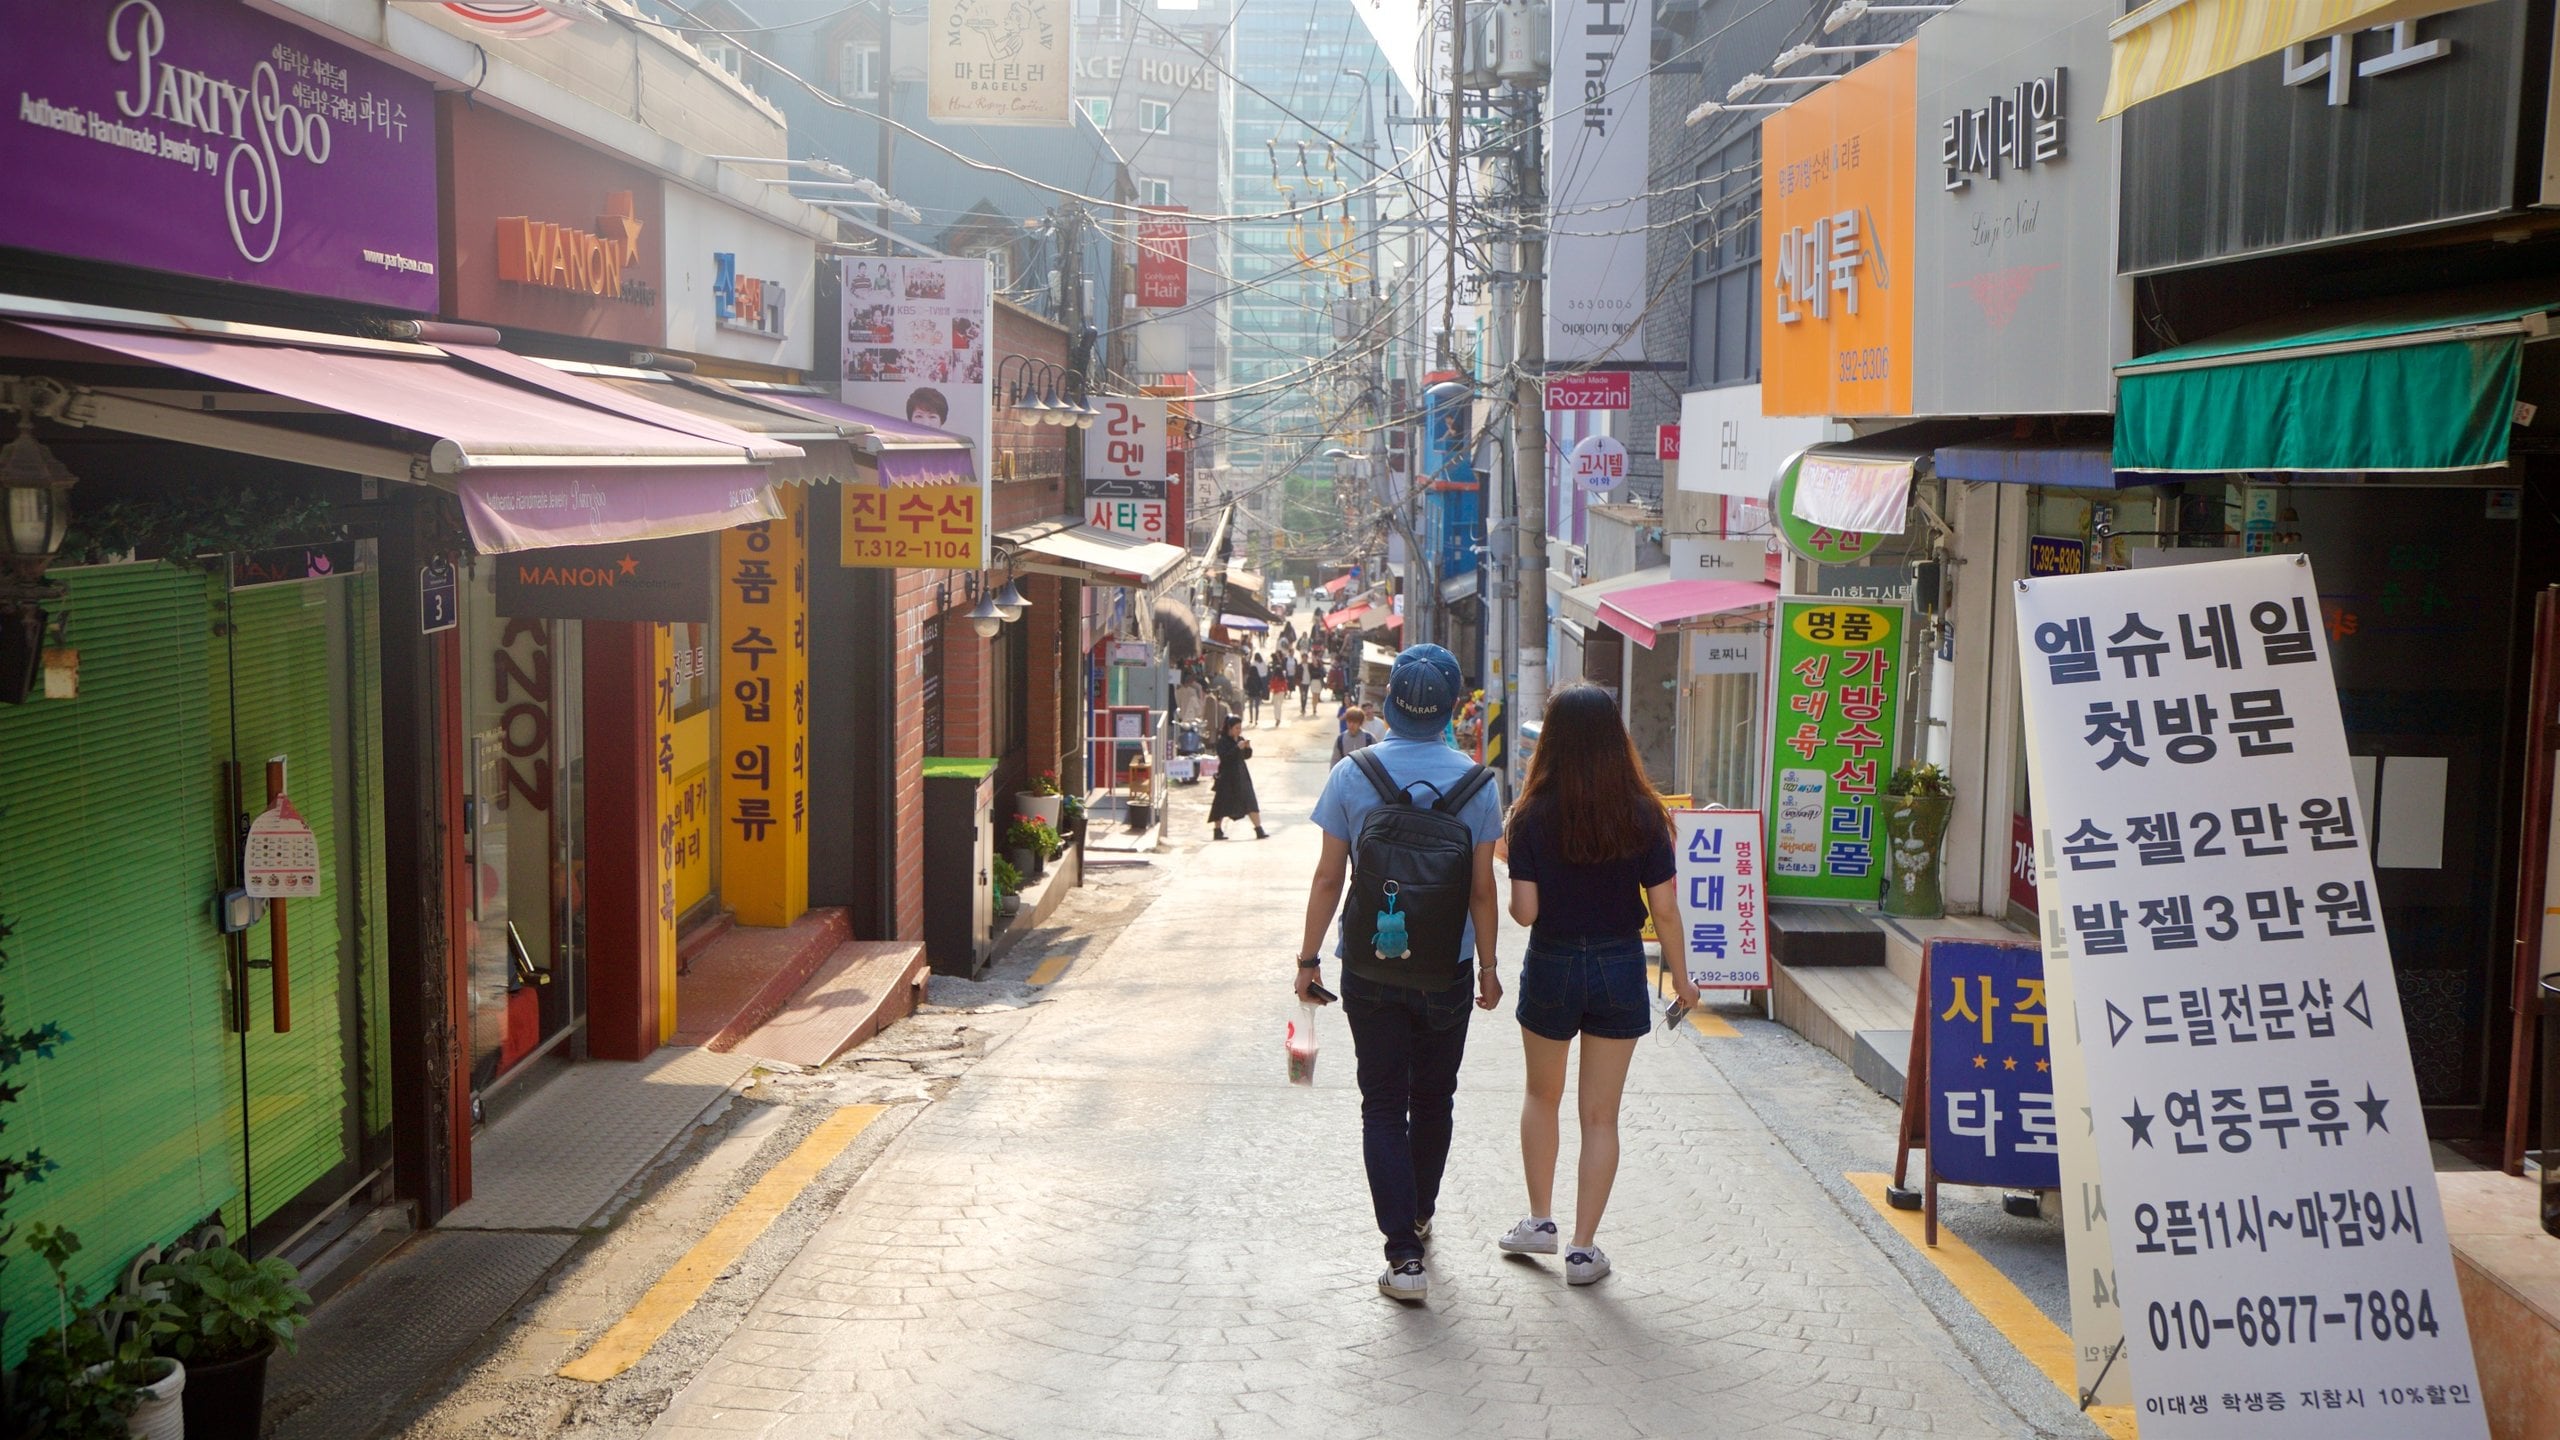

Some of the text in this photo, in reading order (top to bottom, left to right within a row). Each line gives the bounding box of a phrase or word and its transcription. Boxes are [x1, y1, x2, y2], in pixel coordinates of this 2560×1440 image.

[272, 43, 347, 94] 아름다운 사람들의
[955, 62, 1044, 81] 마더린러
[971, 81, 1028, 92] BAGELS
[1142, 56, 1215, 92] HOUSE
[292, 81, 329, 115] 아름다운
[359, 91, 408, 143] 파티수
[1585, 52, 1614, 137] hair
[19, 92, 219, 176] Authentic Handmade Jewelry by
[1942, 66, 2068, 192] 린지네일
[2003, 200, 2041, 240] Nail
[363, 248, 434, 275] www.partysoo.com
[522, 215, 621, 298] MANON
[1775, 209, 1863, 324] 신대륙
[1144, 282, 1180, 297] Hair
[1566, 376, 1609, 385] Hand Made
[1839, 346, 1889, 382] 392-8306
[1549, 386, 1627, 406] Rozzini
[1105, 402, 1146, 477] 라멘
[1578, 453, 1623, 477] 고시텔
[1590, 477, 1611, 487] 이화
[1091, 501, 1163, 532] 사타궁
[855, 540, 971, 560] T.312-1104
[1700, 555, 1721, 568] EH
[2031, 544, 2082, 575] T.392-8306
[519, 566, 614, 587] MANON
[434, 594, 443, 621] 3
[1808, 612, 1873, 642] 명품
[2034, 597, 2318, 685] 엘슈네일
[1708, 647, 1749, 661] 로찌니
[1396, 696, 1438, 714] LE MARAIS
[1787, 654, 1830, 761] 신대륙
[2084, 689, 2295, 771] 첫방문
[2062, 797, 2359, 872] 손젤2만원
[1688, 828, 1728, 960] 신대륙
[1735, 841, 1757, 955] 명품 가방수선
[2073, 880, 2376, 956] 발젤3만원
[1688, 971, 1760, 982] T392-8306
[2142, 978, 2336, 1047] 드릴전문샵
[1944, 1088, 2058, 1157] 타로
[2164, 1079, 2350, 1155] 연중무휴
[2134, 1185, 2423, 1256] 오픈11시~마감9시
[2148, 1288, 2439, 1352] 010-6877-7884
[2146, 1383, 2471, 1416] 이대생 학생증 지참시 10%할인
